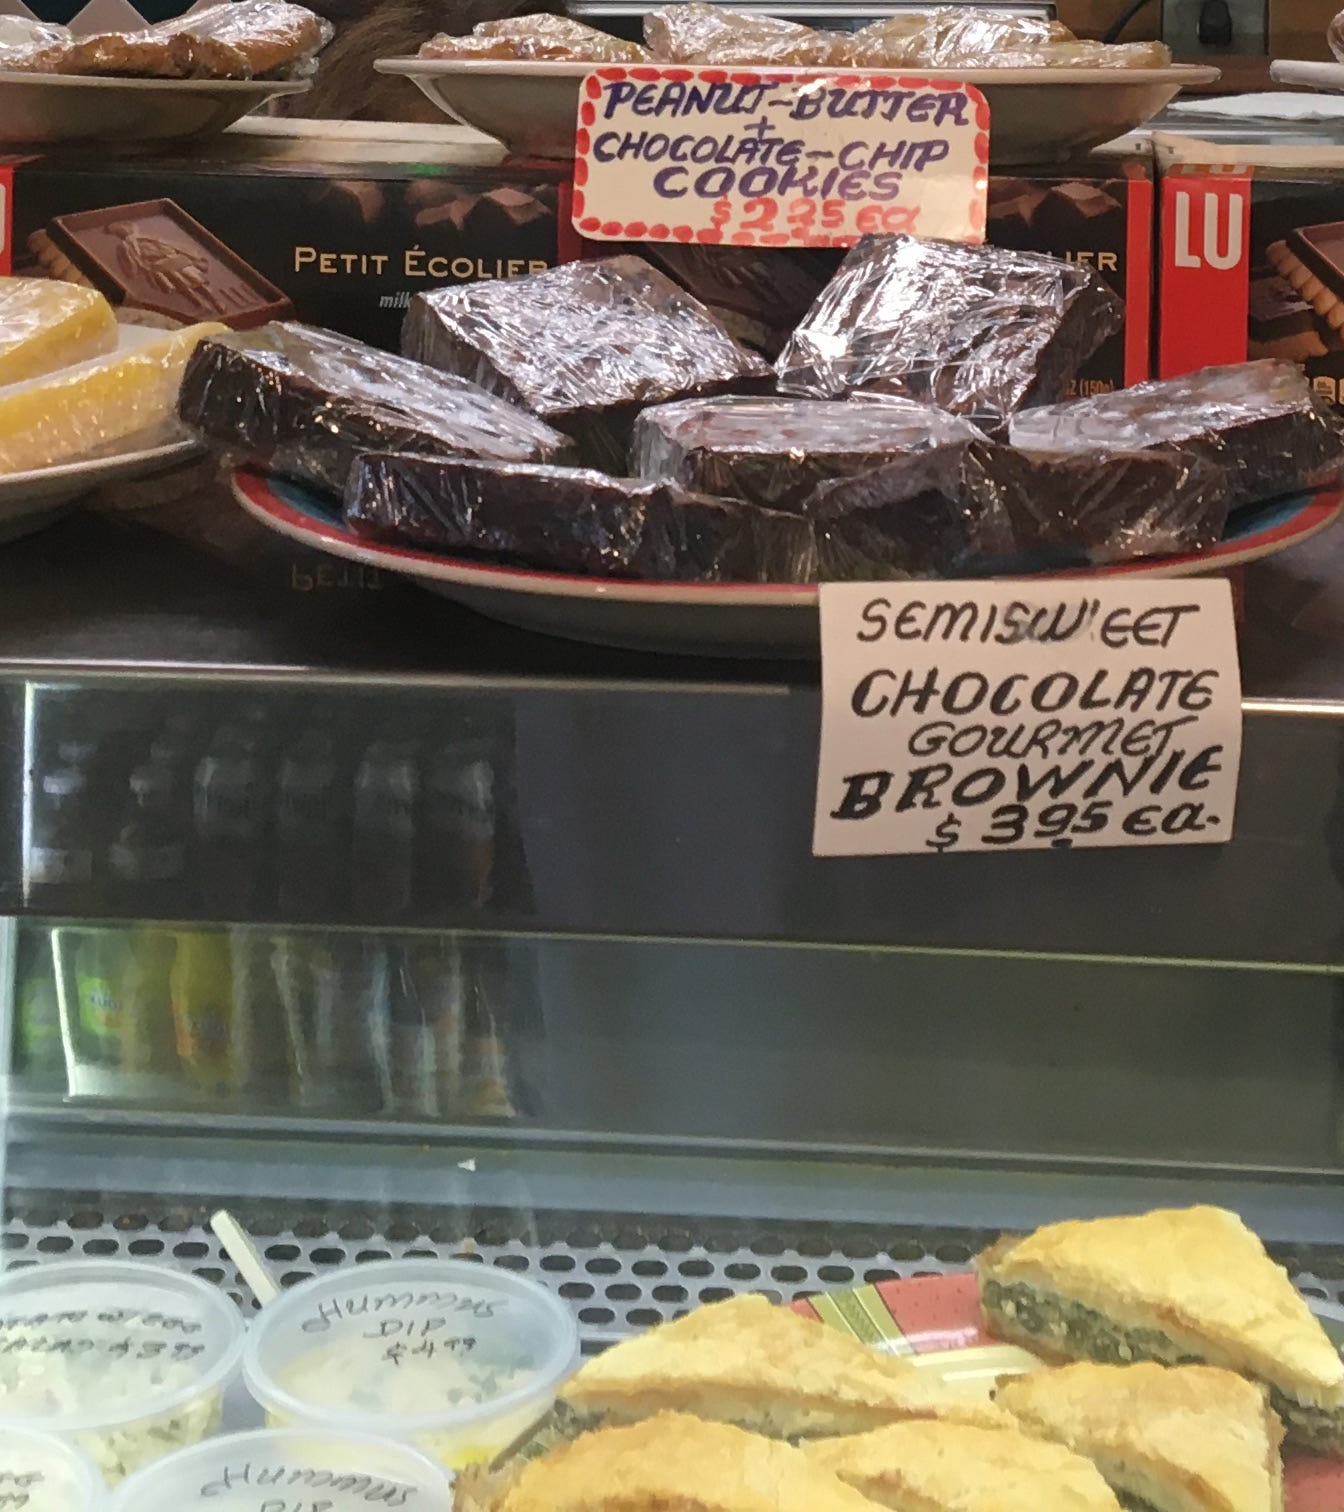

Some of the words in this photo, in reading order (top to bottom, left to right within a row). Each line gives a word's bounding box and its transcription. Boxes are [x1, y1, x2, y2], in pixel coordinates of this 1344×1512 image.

[652, 164, 904, 202] COOKIES
[1173, 190, 1245, 271] LU
[293, 245, 390, 276] PETIT
[378, 290, 414, 310] milk
[856, 597, 1202, 649] SEMISWEET
[850, 665, 1221, 719] CHOCOLATE
[906, 714, 1201, 761] GOURMET
[829, 742, 1224, 822] BROWNIE
